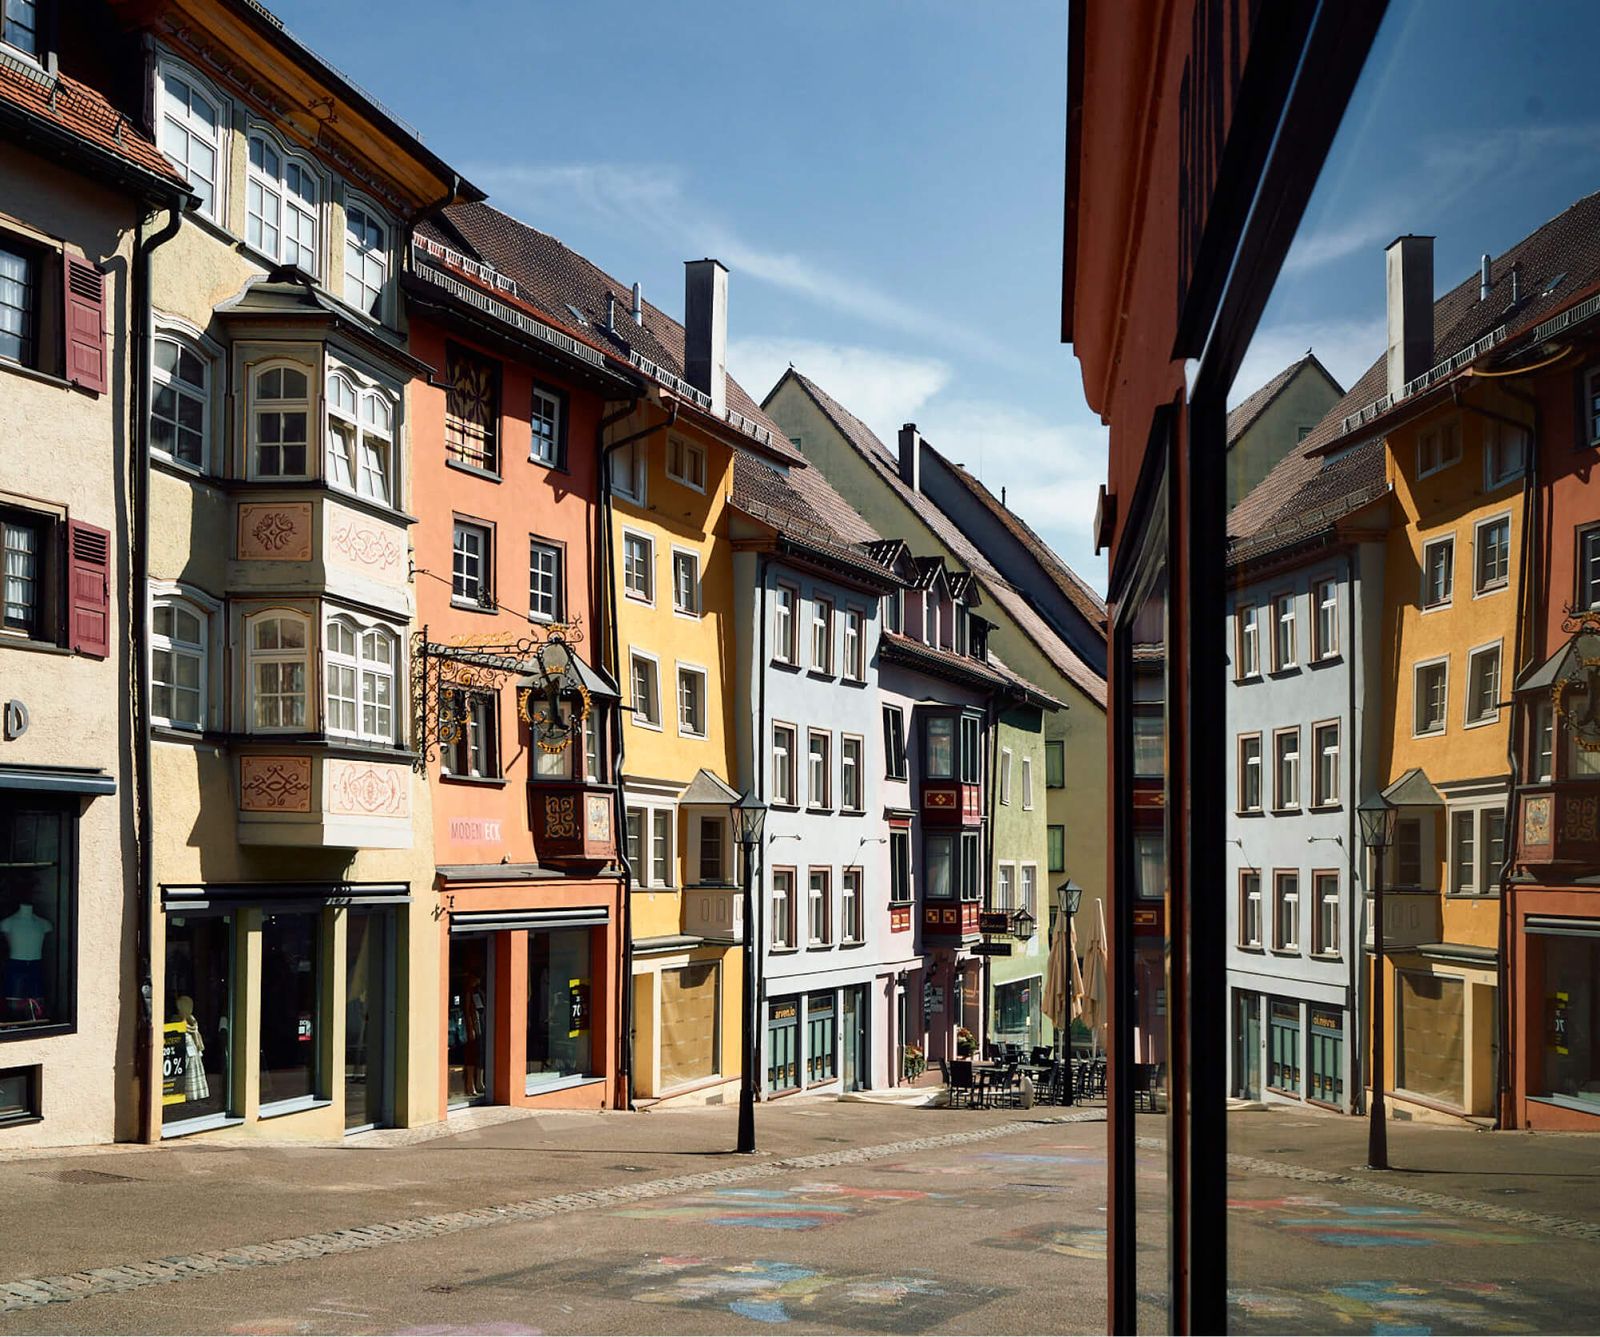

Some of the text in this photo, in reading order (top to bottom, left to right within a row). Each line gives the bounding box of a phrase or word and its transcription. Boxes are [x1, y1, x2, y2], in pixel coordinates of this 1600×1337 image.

[9, 699, 29, 738] D
[451, 822, 501, 841] MODEN ECK
[163, 1057, 183, 1076] 0%
